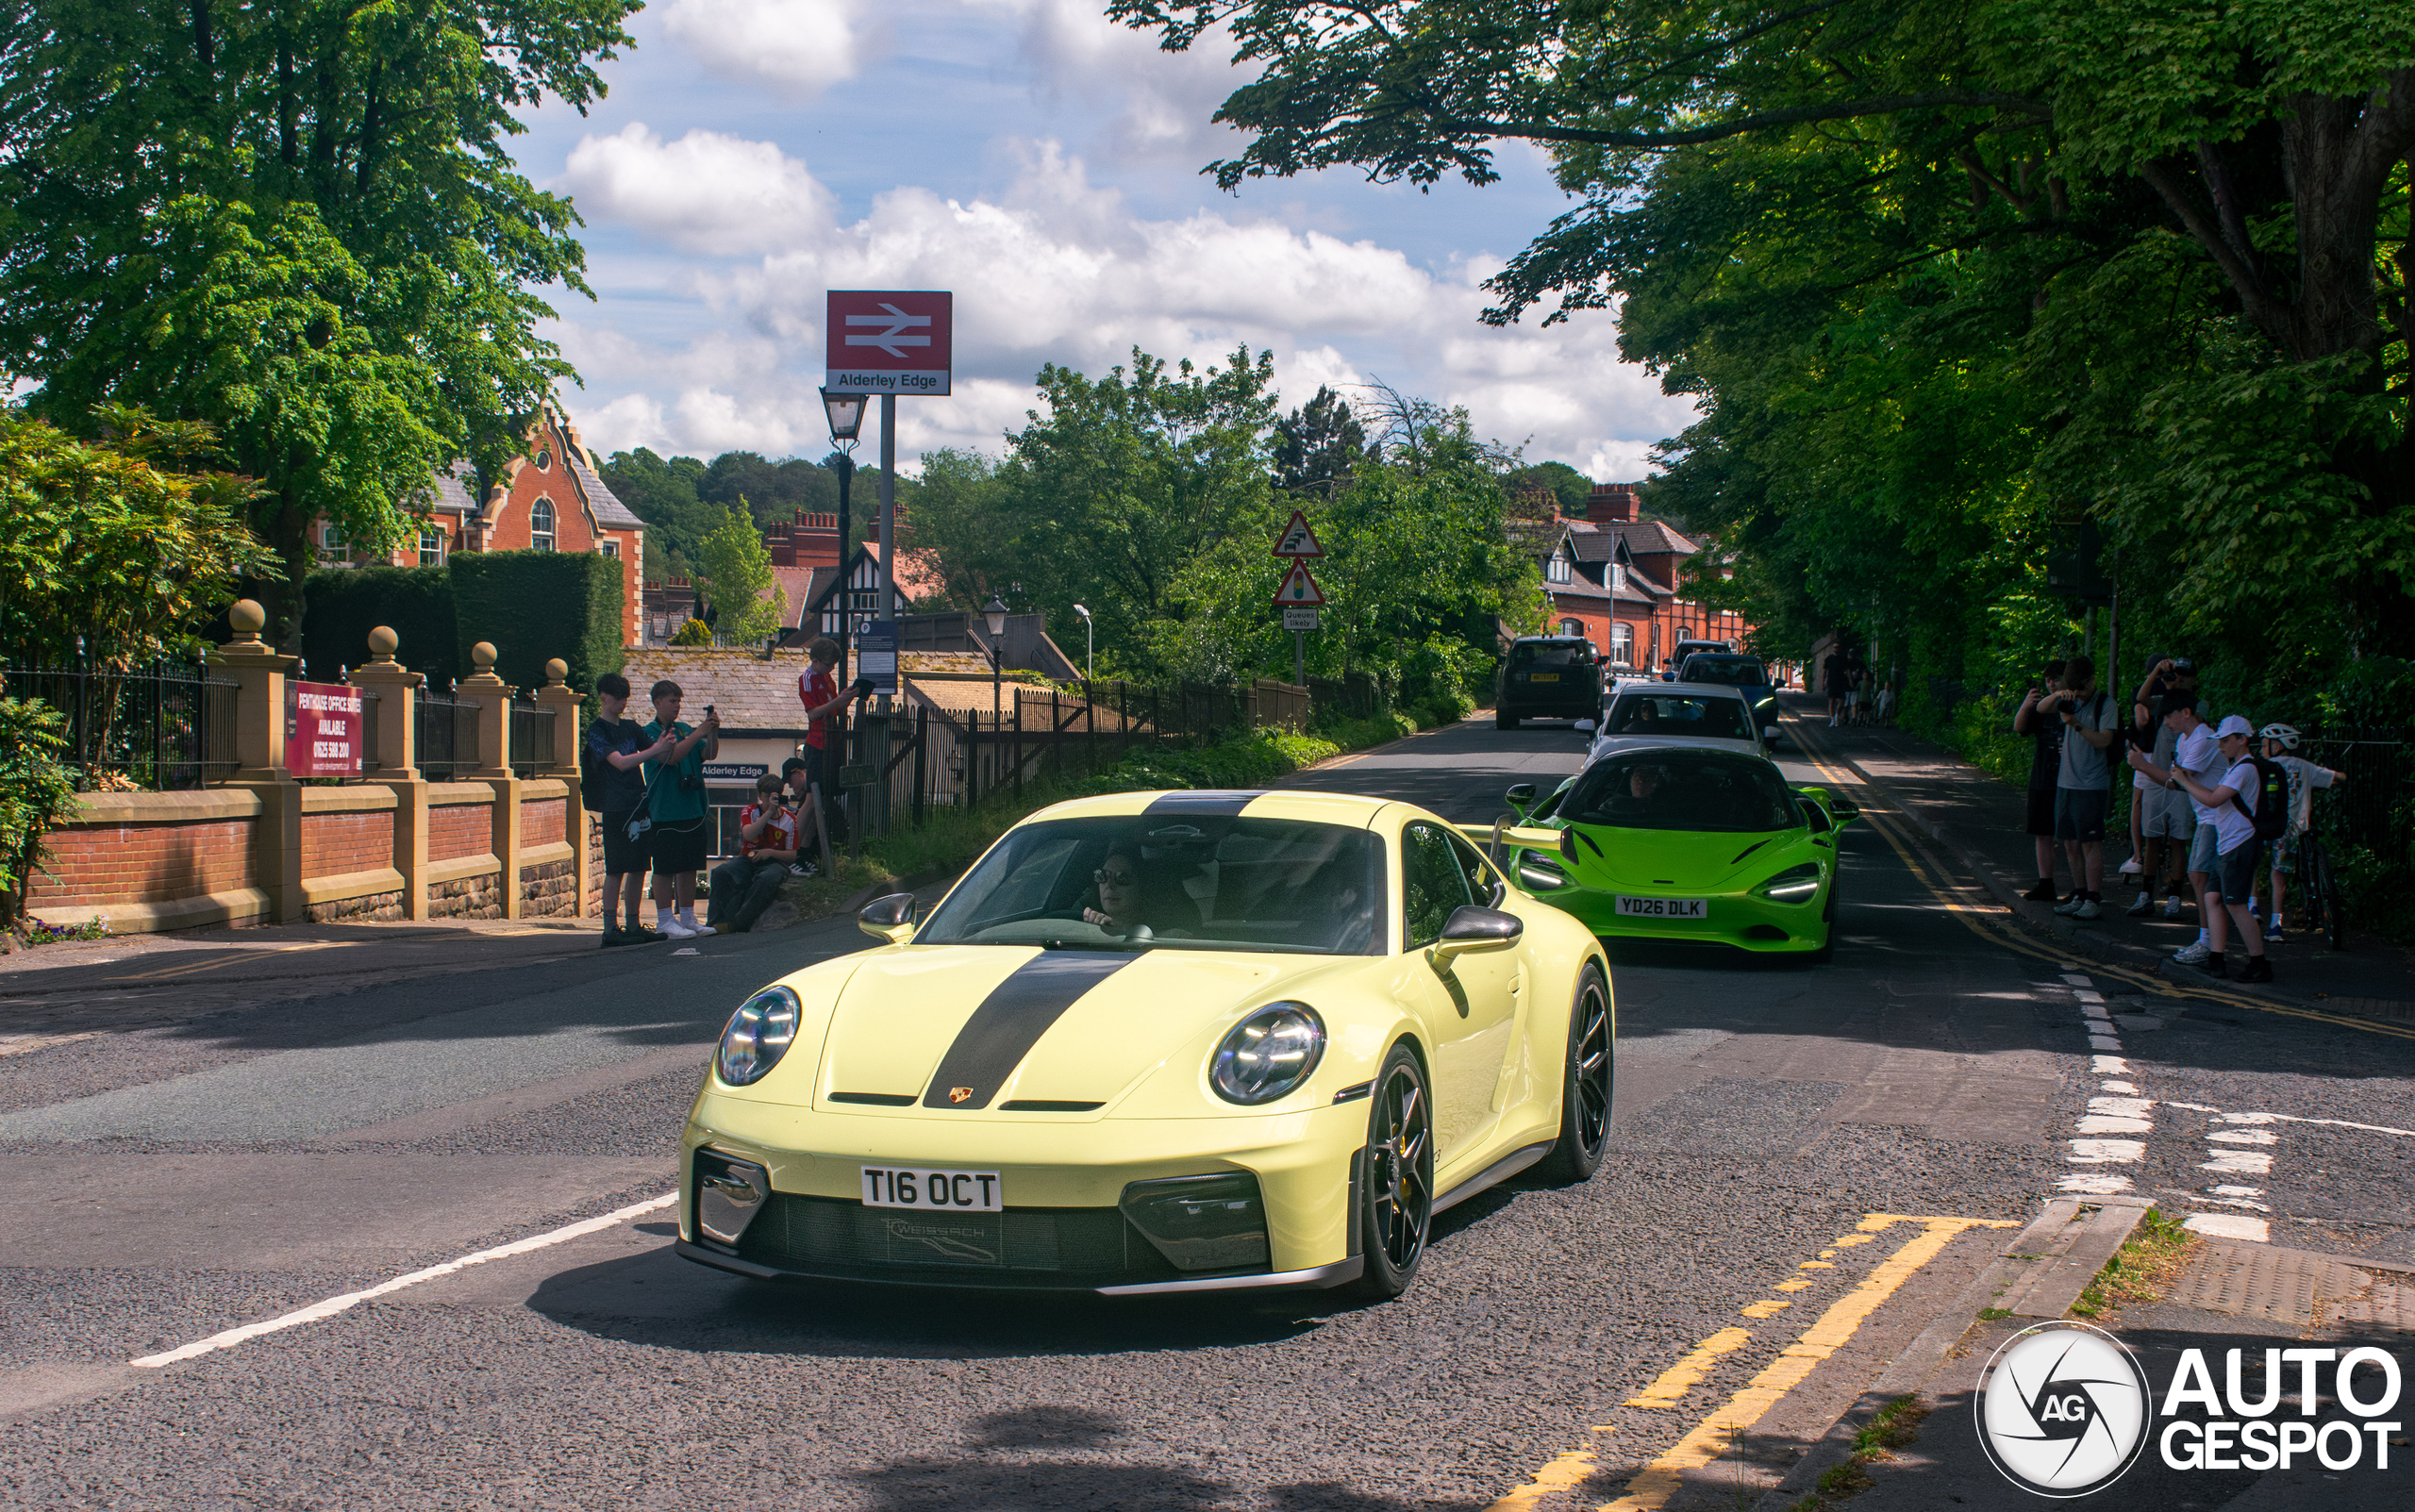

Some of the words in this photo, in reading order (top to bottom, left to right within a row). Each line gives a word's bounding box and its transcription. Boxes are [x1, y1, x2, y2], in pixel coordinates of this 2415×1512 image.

[839, 374, 897, 390] Alderley
[901, 374, 937, 390] Edge
[1290, 619, 1311, 627] likely
[298, 692, 328, 711] PENTHOUSE
[328, 695, 347, 712] OFFICE
[347, 697, 361, 713] SUITES
[318, 719, 346, 736] AVAILABLE
[313, 740, 328, 758] 01625
[339, 741, 350, 758] 200
[702, 766, 738, 776] Alderley
[740, 766, 763, 776] Edge
[1622, 898, 1663, 915] YD26
[1668, 900, 1700, 916] DLK
[864, 1169, 918, 1204] T16
[928, 1172, 996, 1207] OCT
[896, 1224, 985, 1238] WEISSACH
